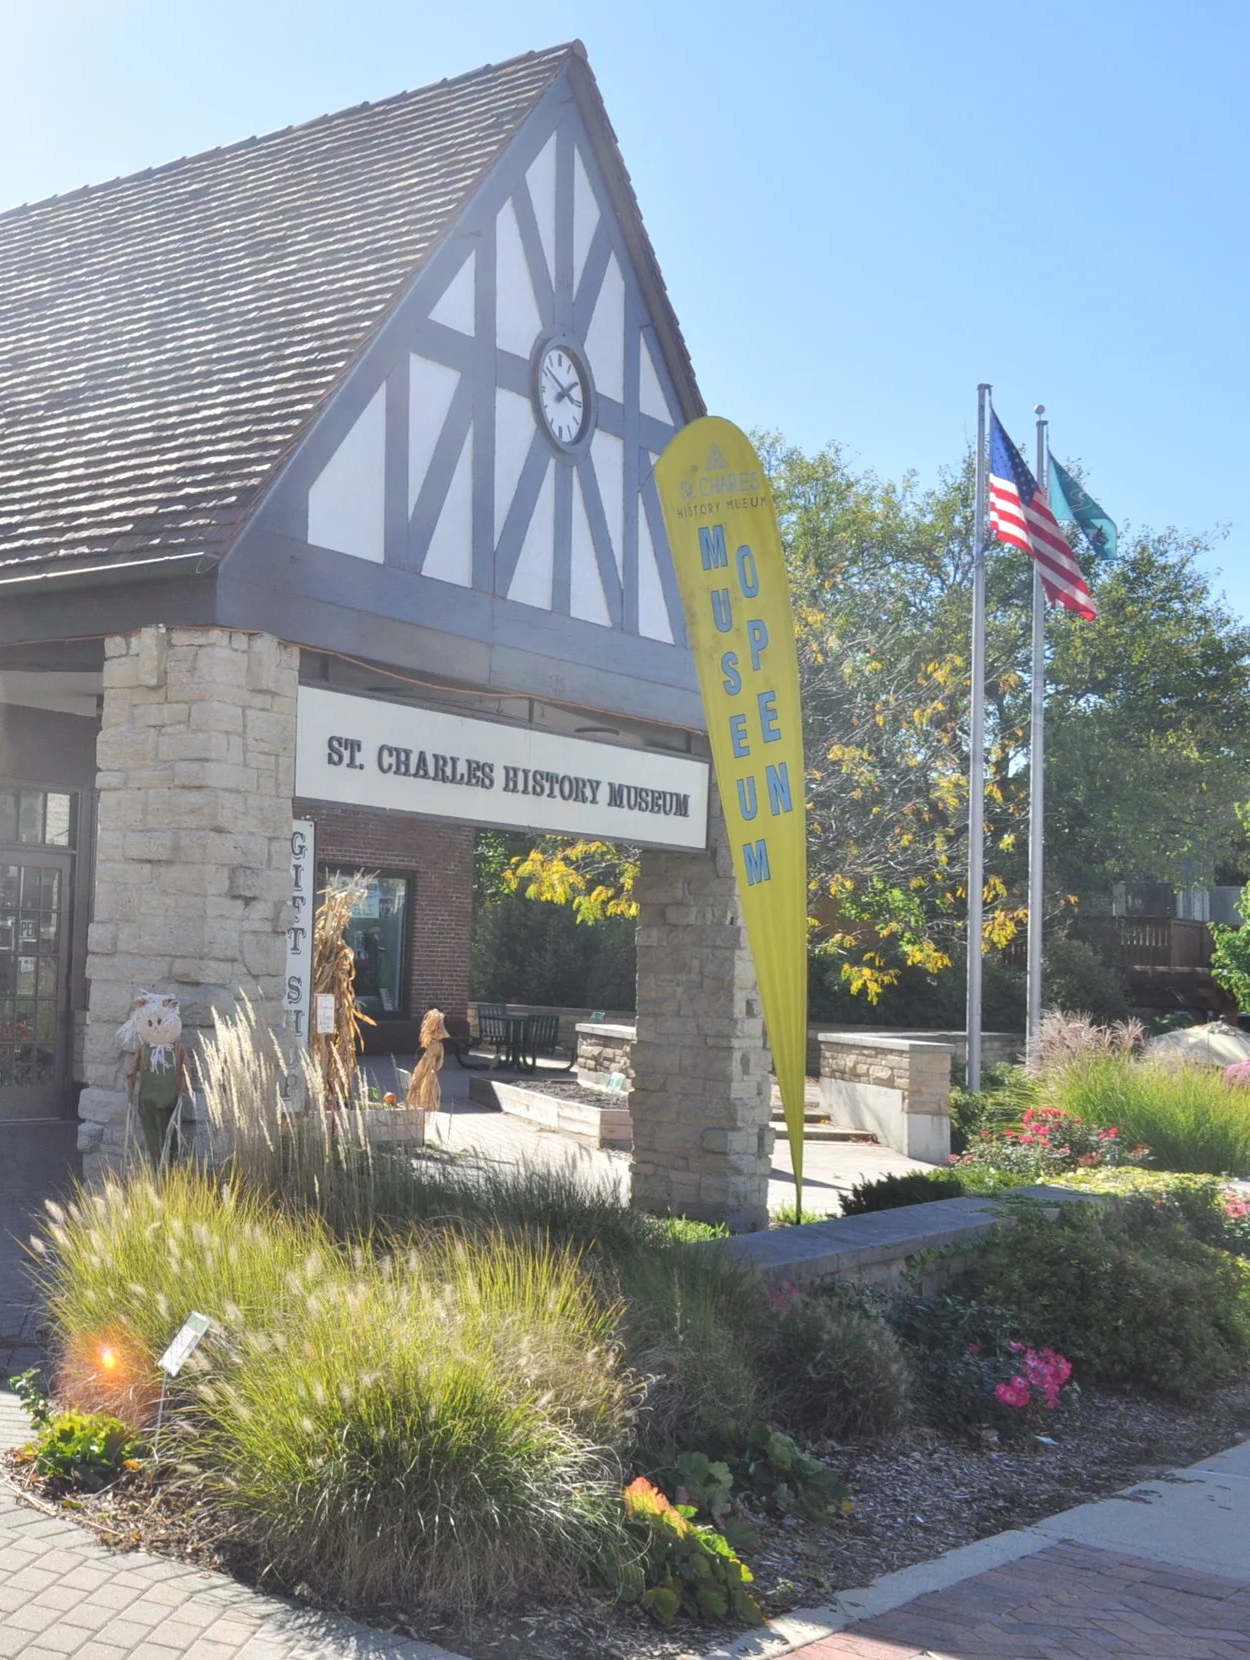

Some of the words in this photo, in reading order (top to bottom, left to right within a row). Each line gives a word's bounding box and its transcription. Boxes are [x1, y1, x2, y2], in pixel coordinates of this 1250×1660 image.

[677, 502, 720, 520] HISTORY
[699, 471, 760, 496] CHARES
[698, 524, 771, 886] MUSEUM
[736, 545, 793, 816] OPEN
[327, 735, 365, 771] ST.
[377, 744, 494, 790] CHARLES
[503, 765, 602, 804] HISTORY
[607, 782, 690, 817] MUSEUM
